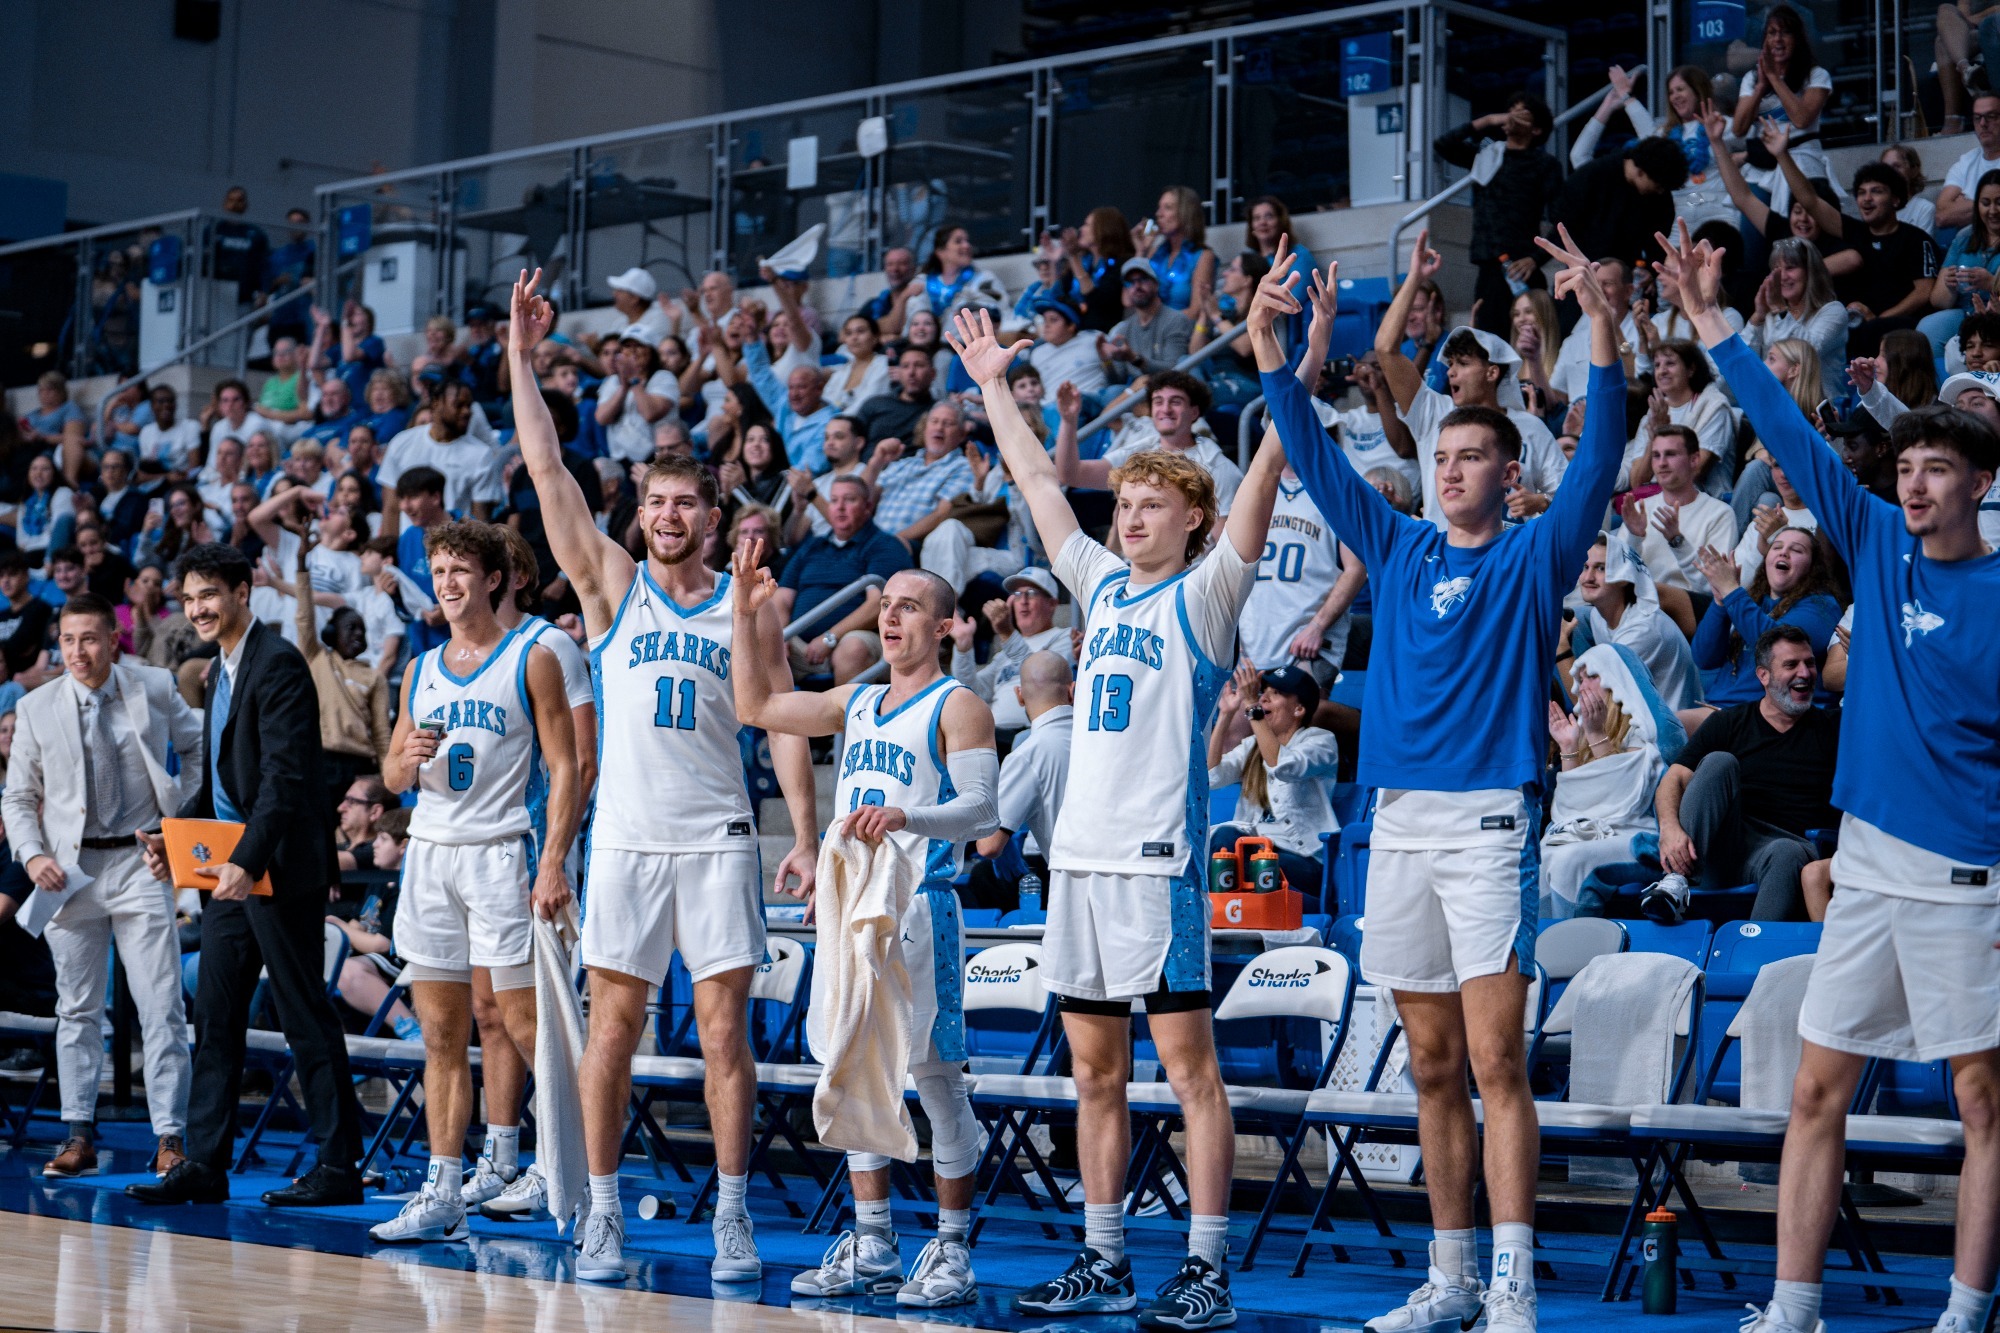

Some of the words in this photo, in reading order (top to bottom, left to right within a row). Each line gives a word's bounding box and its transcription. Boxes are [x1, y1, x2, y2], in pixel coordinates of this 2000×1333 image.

[1697, 19, 1724, 38] 103
[1270, 514, 1321, 541] HINGTON
[1256, 541, 1306, 582] 20
[629, 631, 731, 681] SHARKS
[1084, 622, 1164, 672] SHARKS
[654, 676, 696, 731] 11
[1088, 674, 1133, 732] 13
[448, 743, 474, 792] 6
[843, 738, 916, 787] SHARKS
[1218, 869, 1235, 888] G
[1258, 871, 1274, 889] G
[1225, 898, 1243, 924] G
[967, 965, 1022, 983] Sharks
[1248, 967, 1312, 988] Sharks
